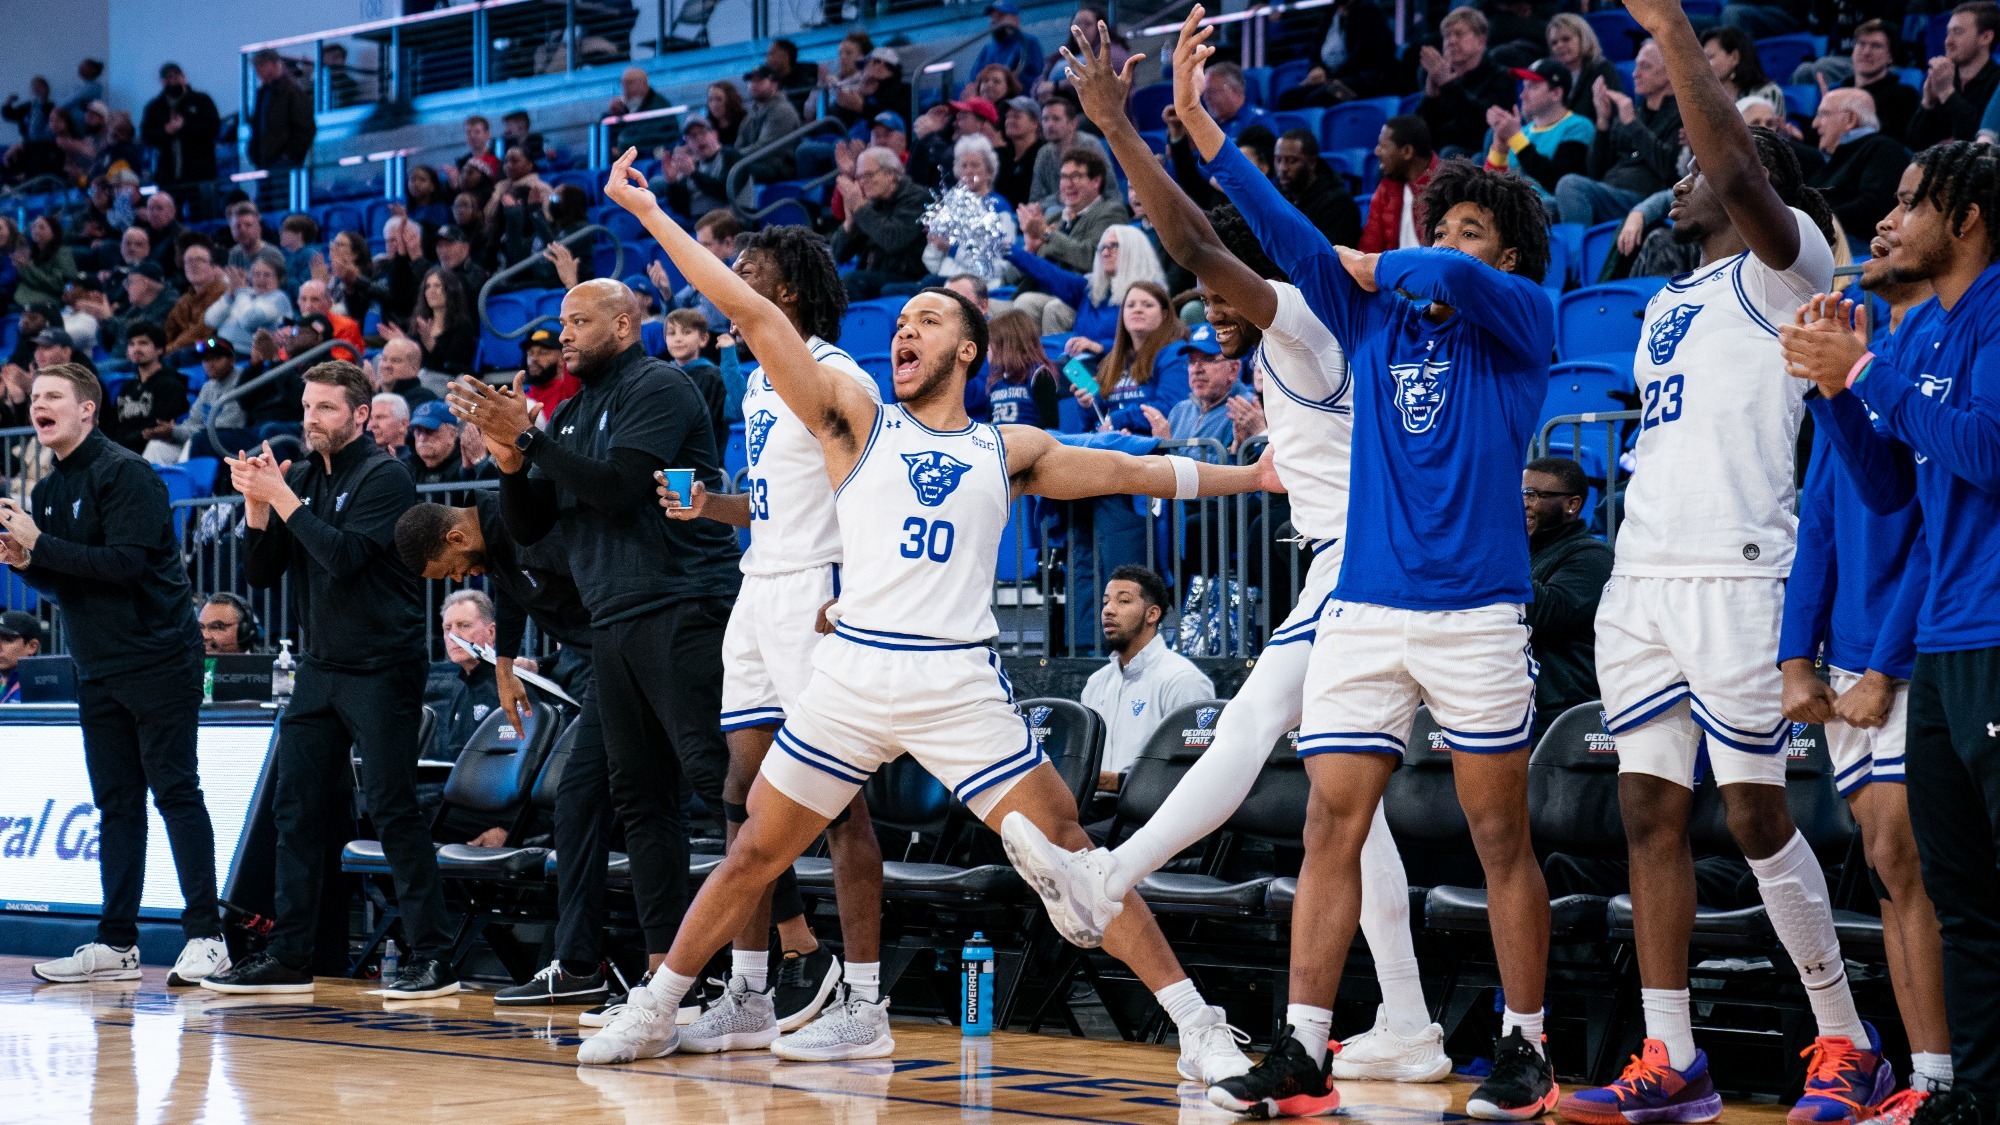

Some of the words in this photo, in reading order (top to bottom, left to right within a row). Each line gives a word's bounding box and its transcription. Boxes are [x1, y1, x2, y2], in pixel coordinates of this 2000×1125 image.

[1643, 373, 1684, 431] 23
[899, 516, 955, 563] 30
[1181, 729, 1217, 737] GEORGIA
[1184, 736, 1210, 745] STATE
[1789, 738, 1816, 748] RGIA
[1787, 747, 1808, 757] ATE
[967, 962, 978, 1023] POWERADE
